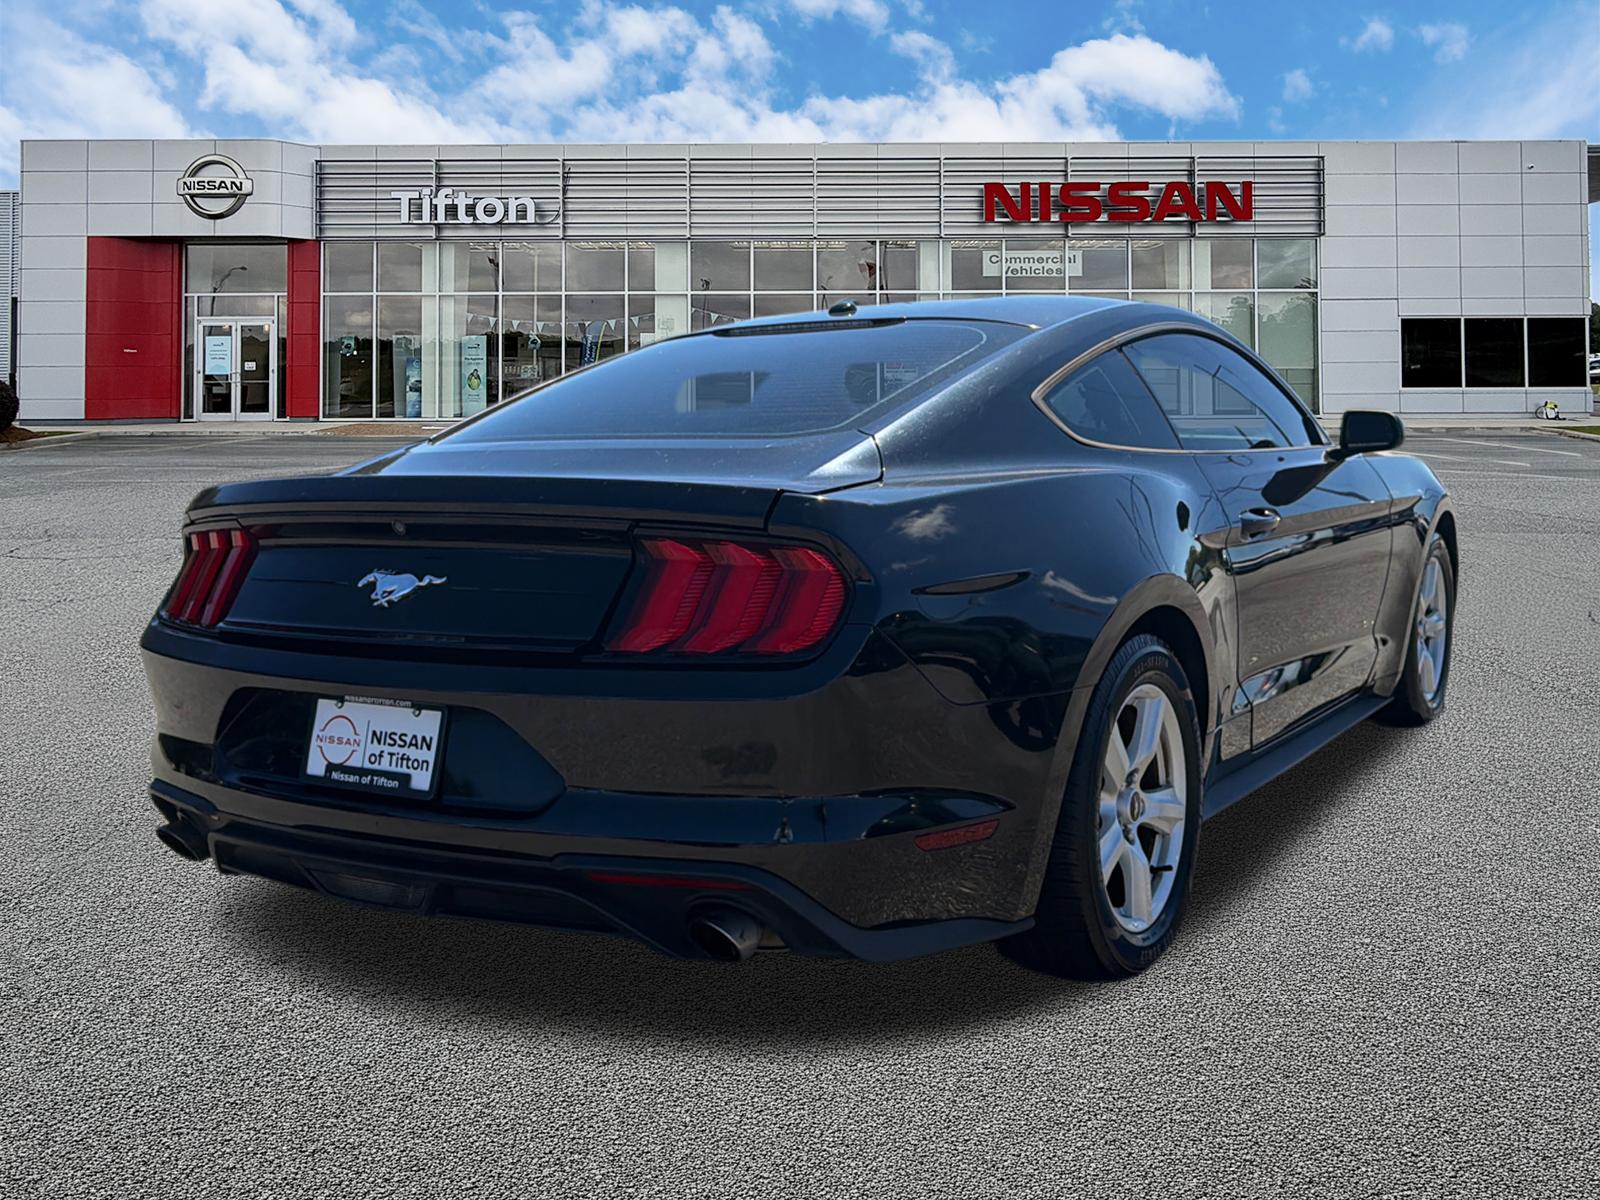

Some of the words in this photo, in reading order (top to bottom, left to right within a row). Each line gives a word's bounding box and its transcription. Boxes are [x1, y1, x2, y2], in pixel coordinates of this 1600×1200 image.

[182, 180, 243, 192] NISSAN
[390, 188, 536, 225] Tifton
[983, 181, 1253, 223] NISSAN
[316, 734, 361, 747] NISSAN
[370, 730, 433, 751] NISSAN
[368, 750, 385, 766] of
[387, 751, 429, 772] Tifton
[331, 771, 359, 783] Nissan
[360, 774, 371, 785] of
[373, 776, 399, 788] Tifton
